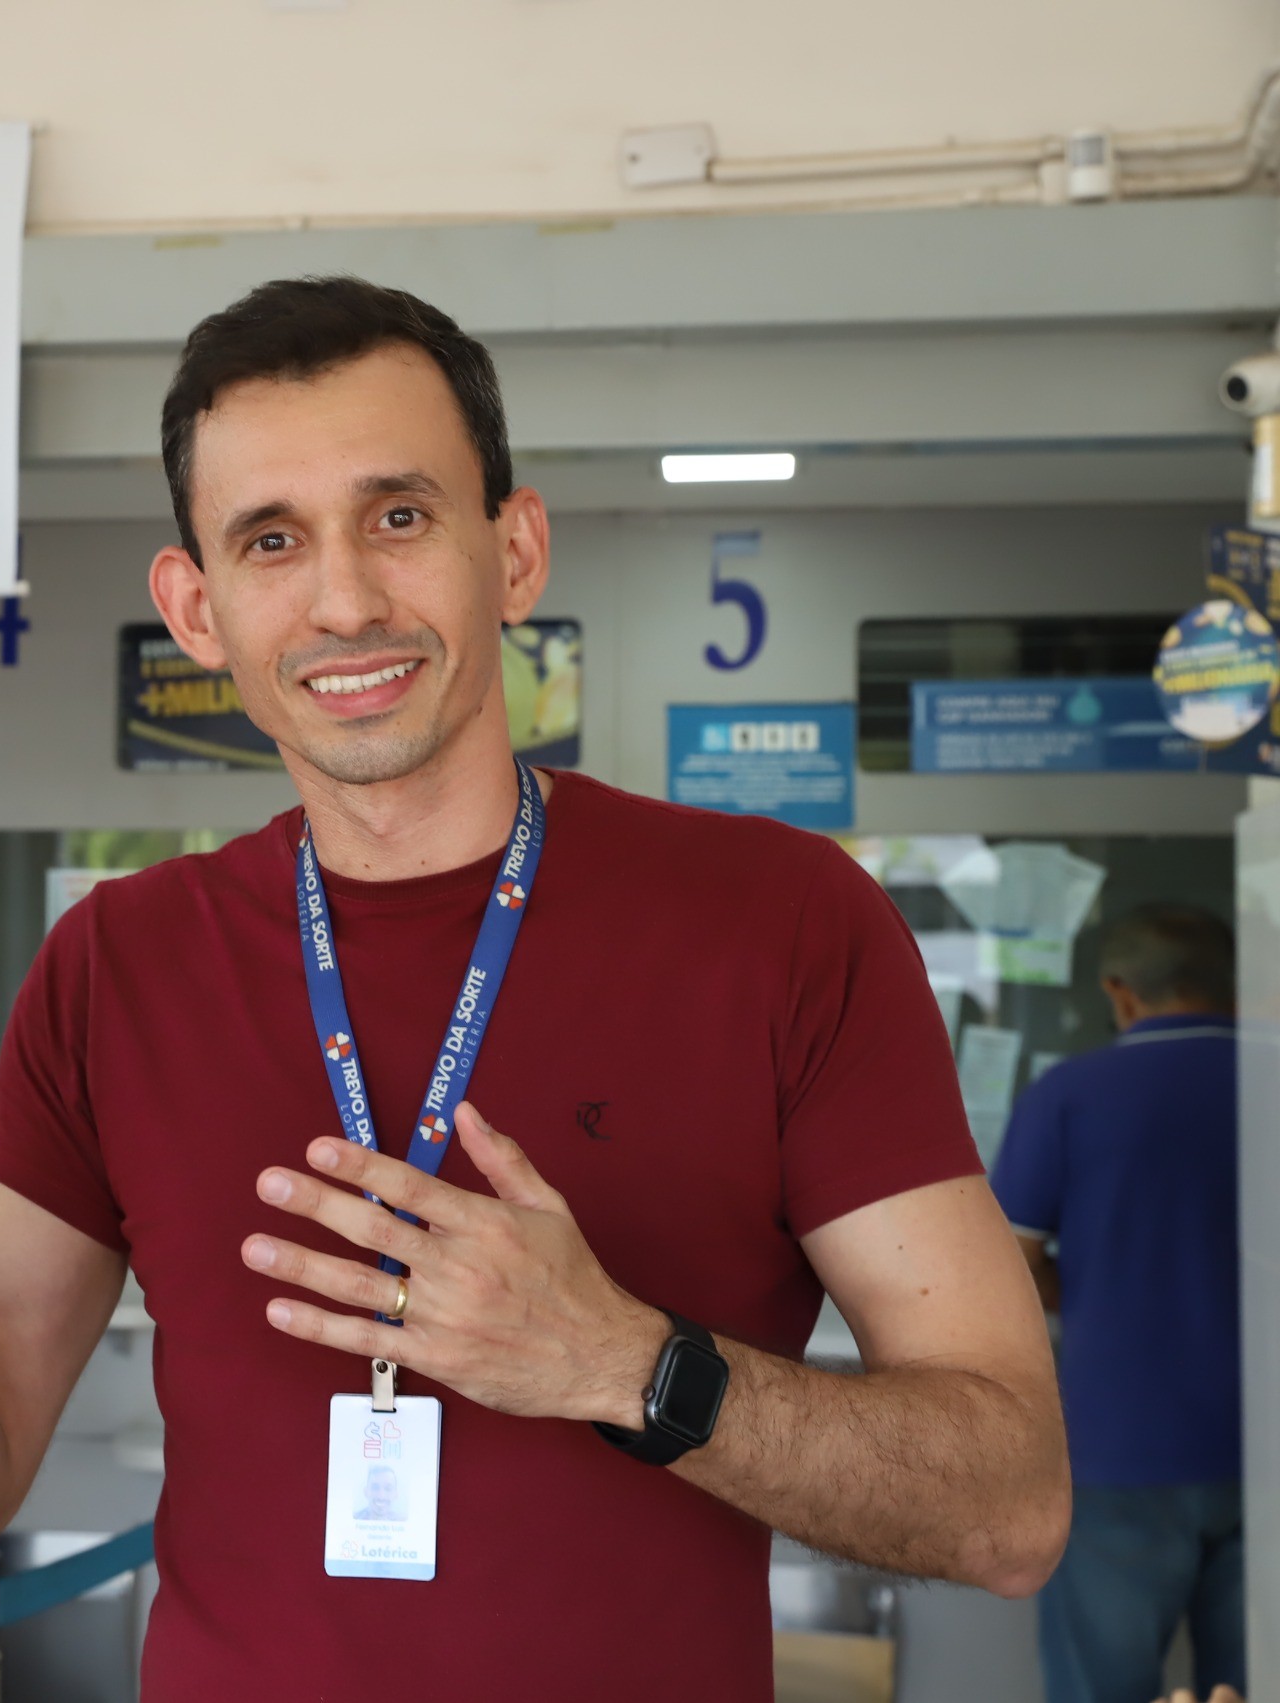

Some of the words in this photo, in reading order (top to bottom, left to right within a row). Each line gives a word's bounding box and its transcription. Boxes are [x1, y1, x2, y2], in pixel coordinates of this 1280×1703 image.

[705, 531, 767, 672] 5
[303, 840, 317, 892] TREVO
[503, 824, 531, 879] TREVO
[520, 799, 532, 824] DA
[296, 883, 310, 942] LOTERIA
[308, 894, 323, 920] DA
[312, 920, 334, 971] SORTE
[456, 966, 487, 1023] SORTE
[446, 1025, 467, 1053] DA
[457, 1010, 487, 1078] LOTERIA
[341, 1057, 365, 1115] TREVO
[356, 1118, 372, 1146] DA
[426, 1054, 456, 1112] TREVO
[361, 1545, 418, 1559] Lotérica
